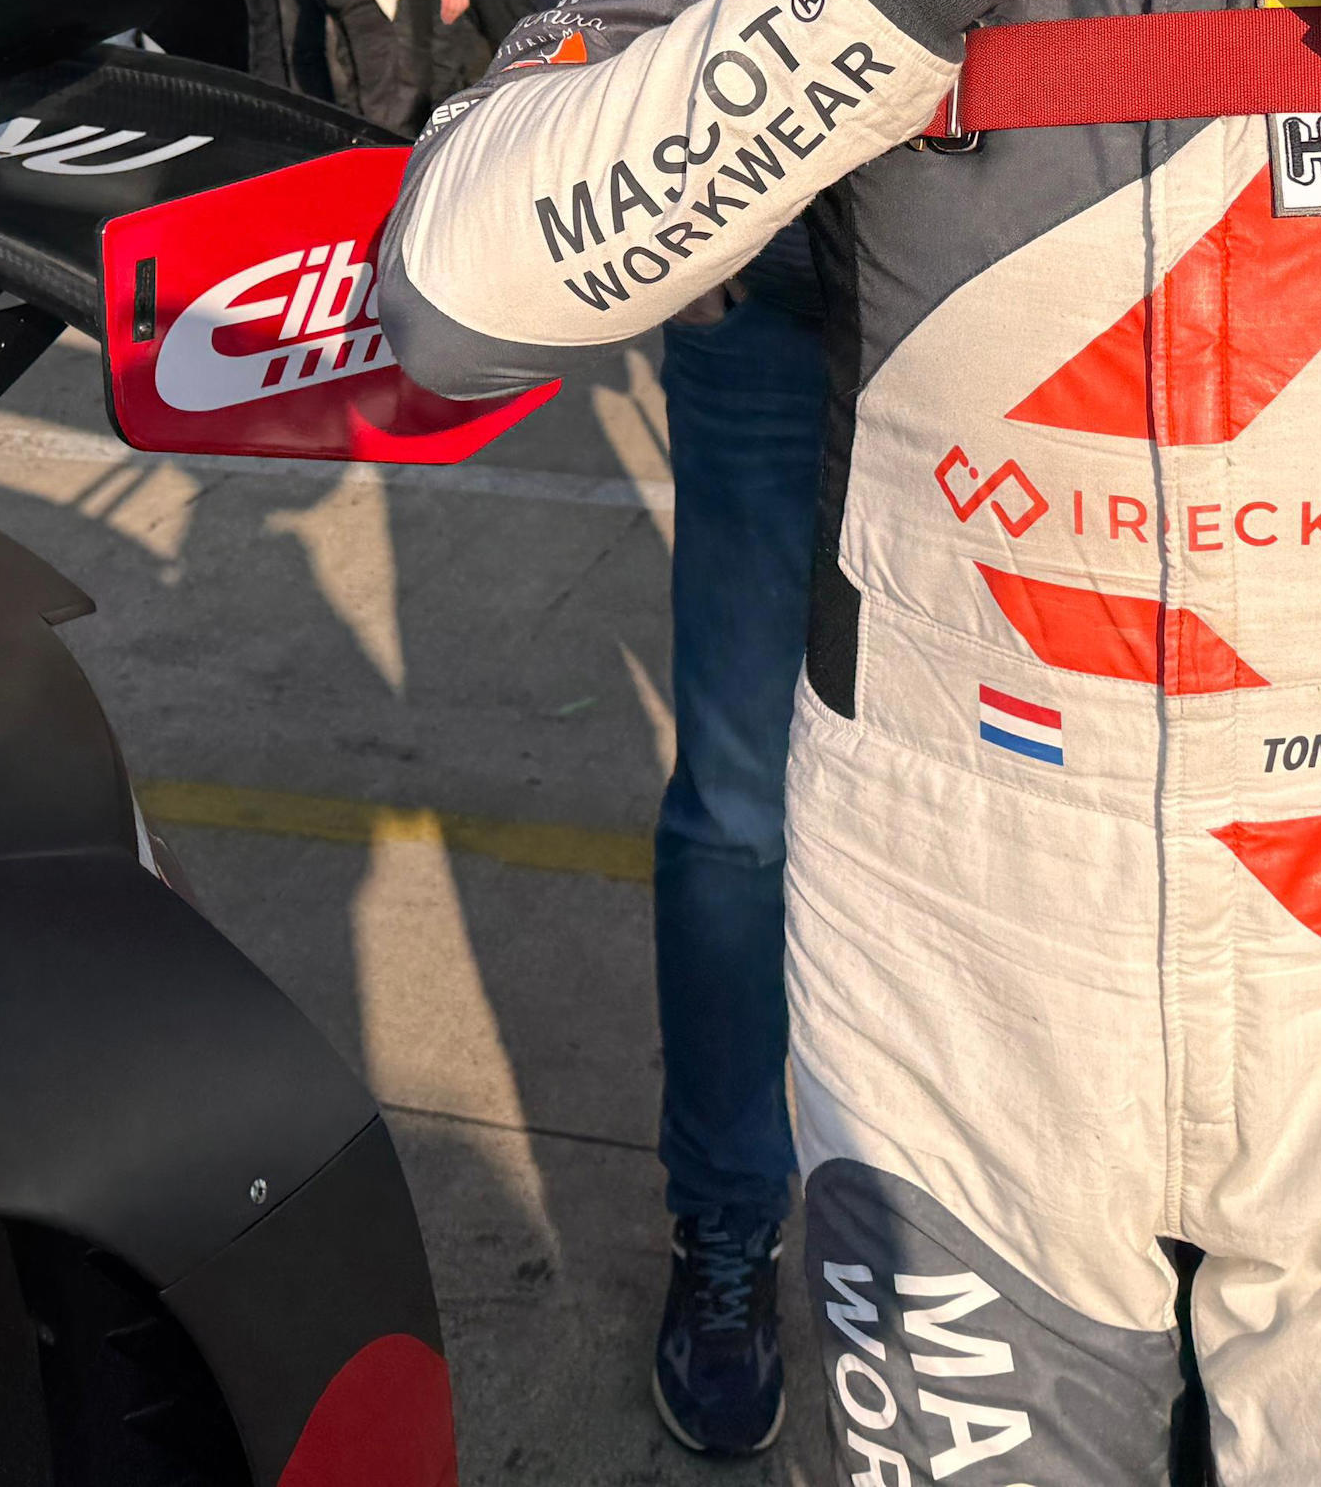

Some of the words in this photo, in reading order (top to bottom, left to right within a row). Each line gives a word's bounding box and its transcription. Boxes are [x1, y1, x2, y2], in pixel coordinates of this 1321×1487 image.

[564, 41, 896, 312] WORKWEAR
[155, 239, 401, 412] Eib
[894, 1271, 1037, 1487] MA
